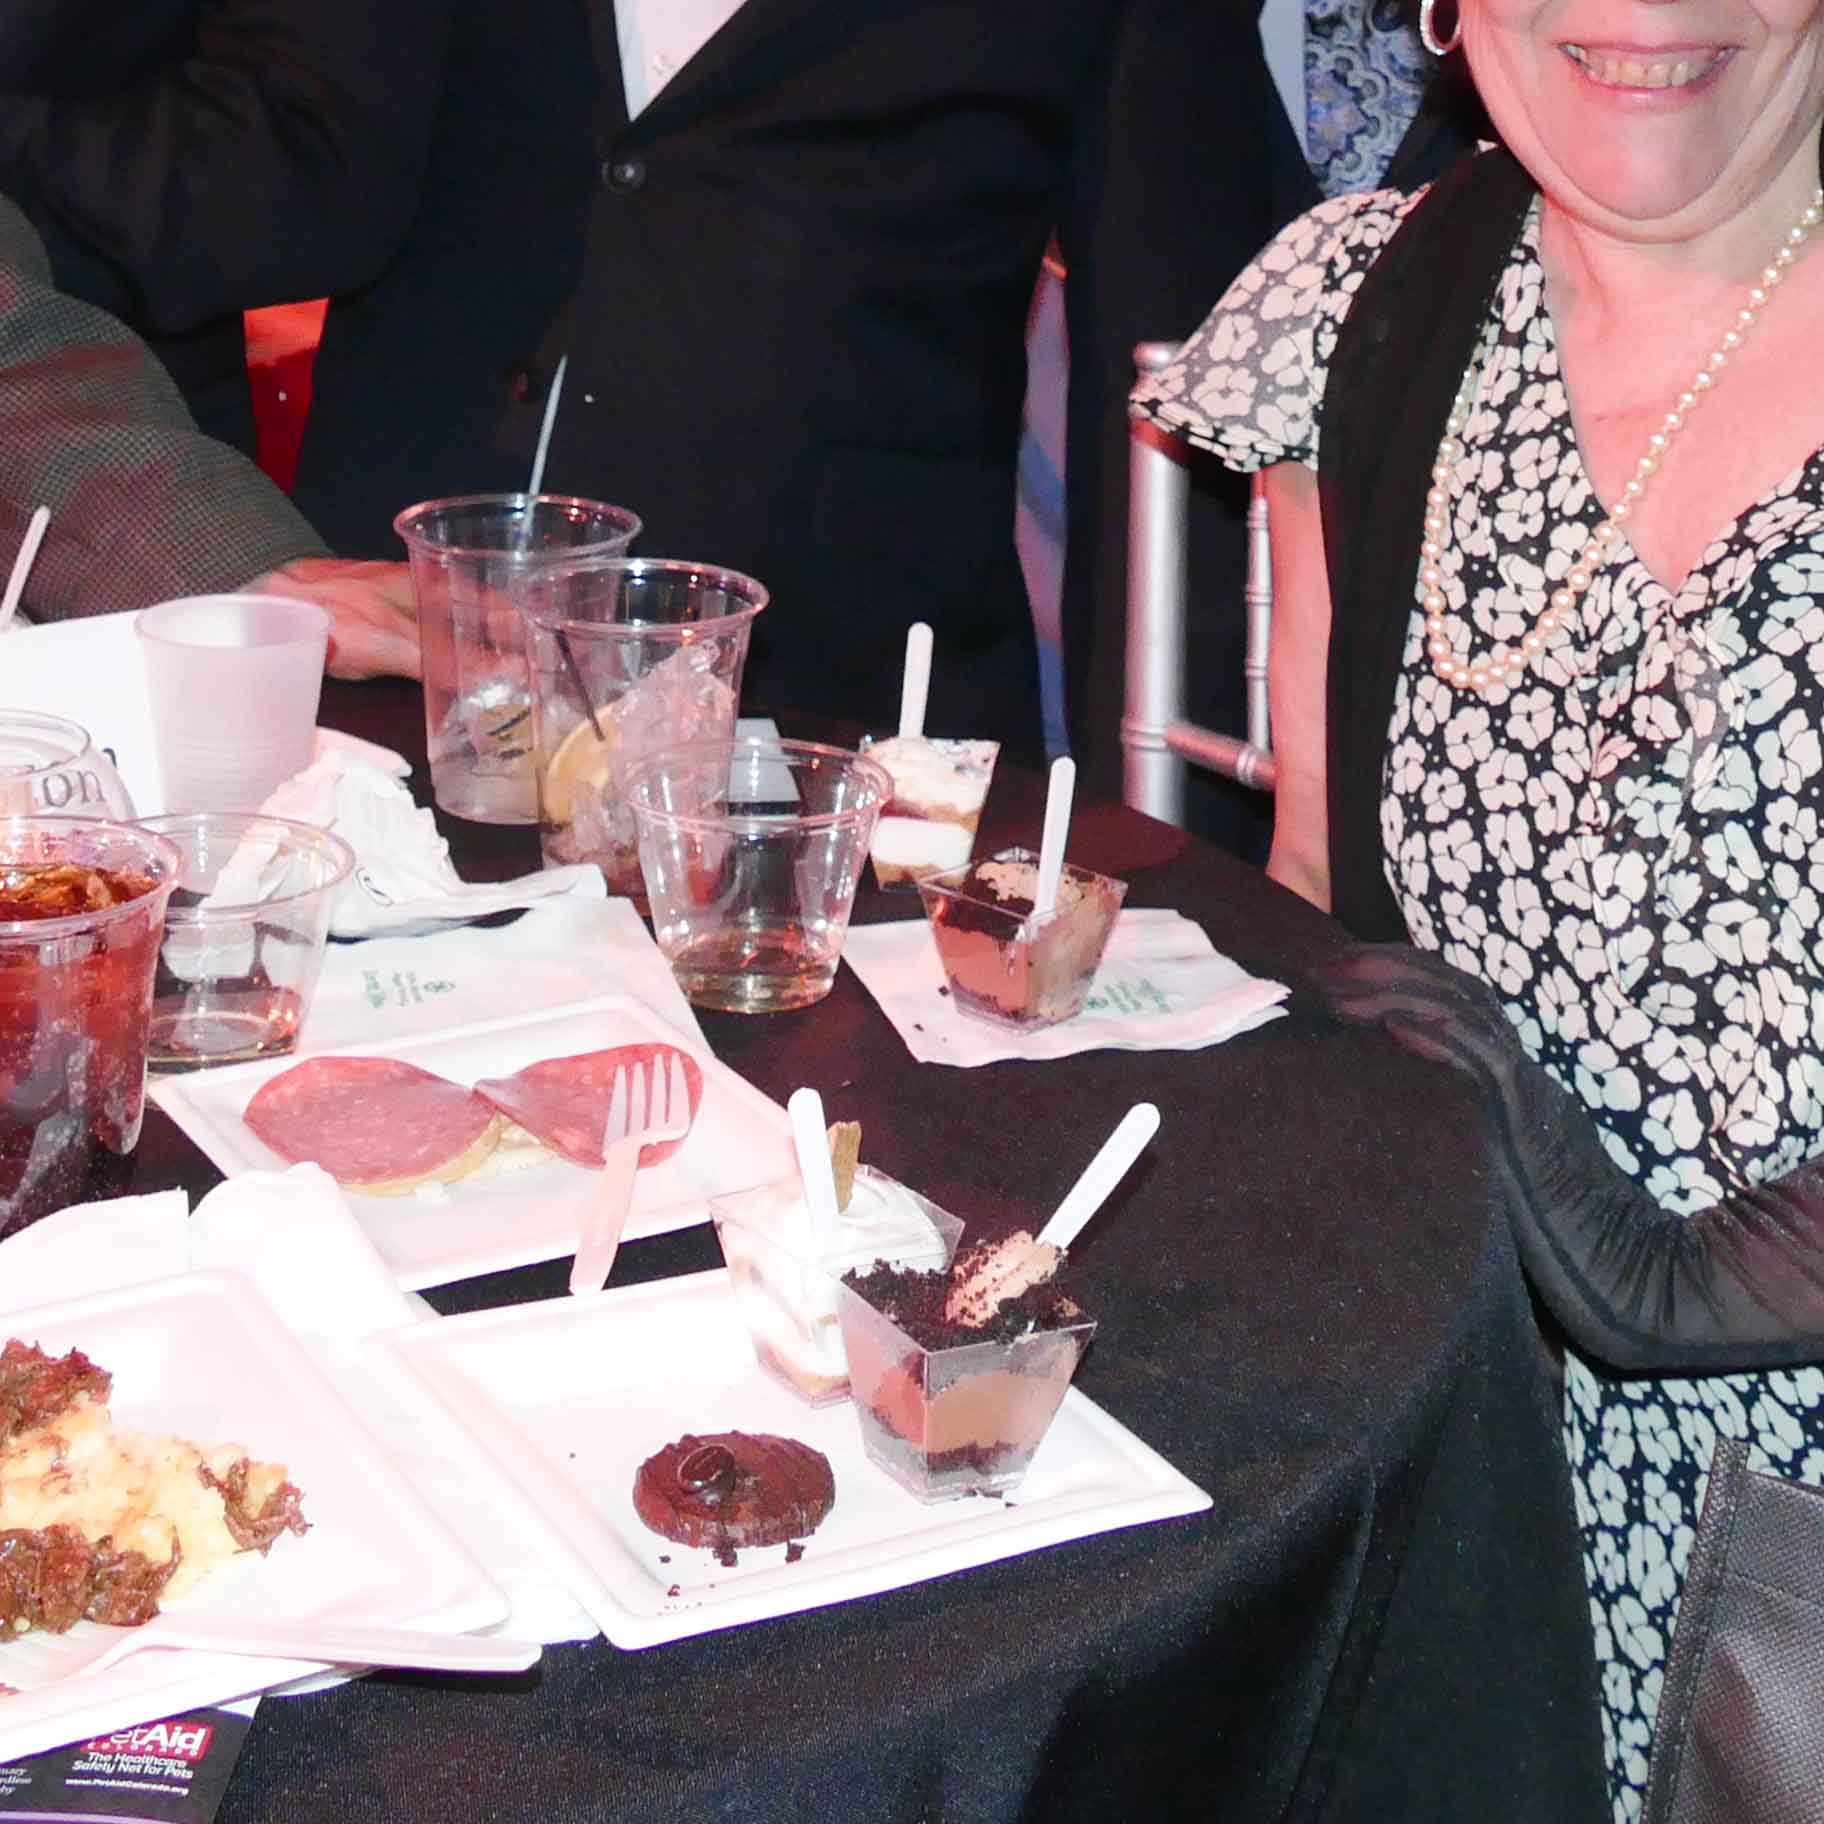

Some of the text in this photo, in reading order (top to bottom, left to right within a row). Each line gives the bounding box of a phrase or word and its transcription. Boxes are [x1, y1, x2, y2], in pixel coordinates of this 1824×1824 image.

[106, 1723, 208, 1754] etAid
[72, 1760, 194, 1780] Safety Net for Pets
[113, 1753, 188, 1769] Healthcare
